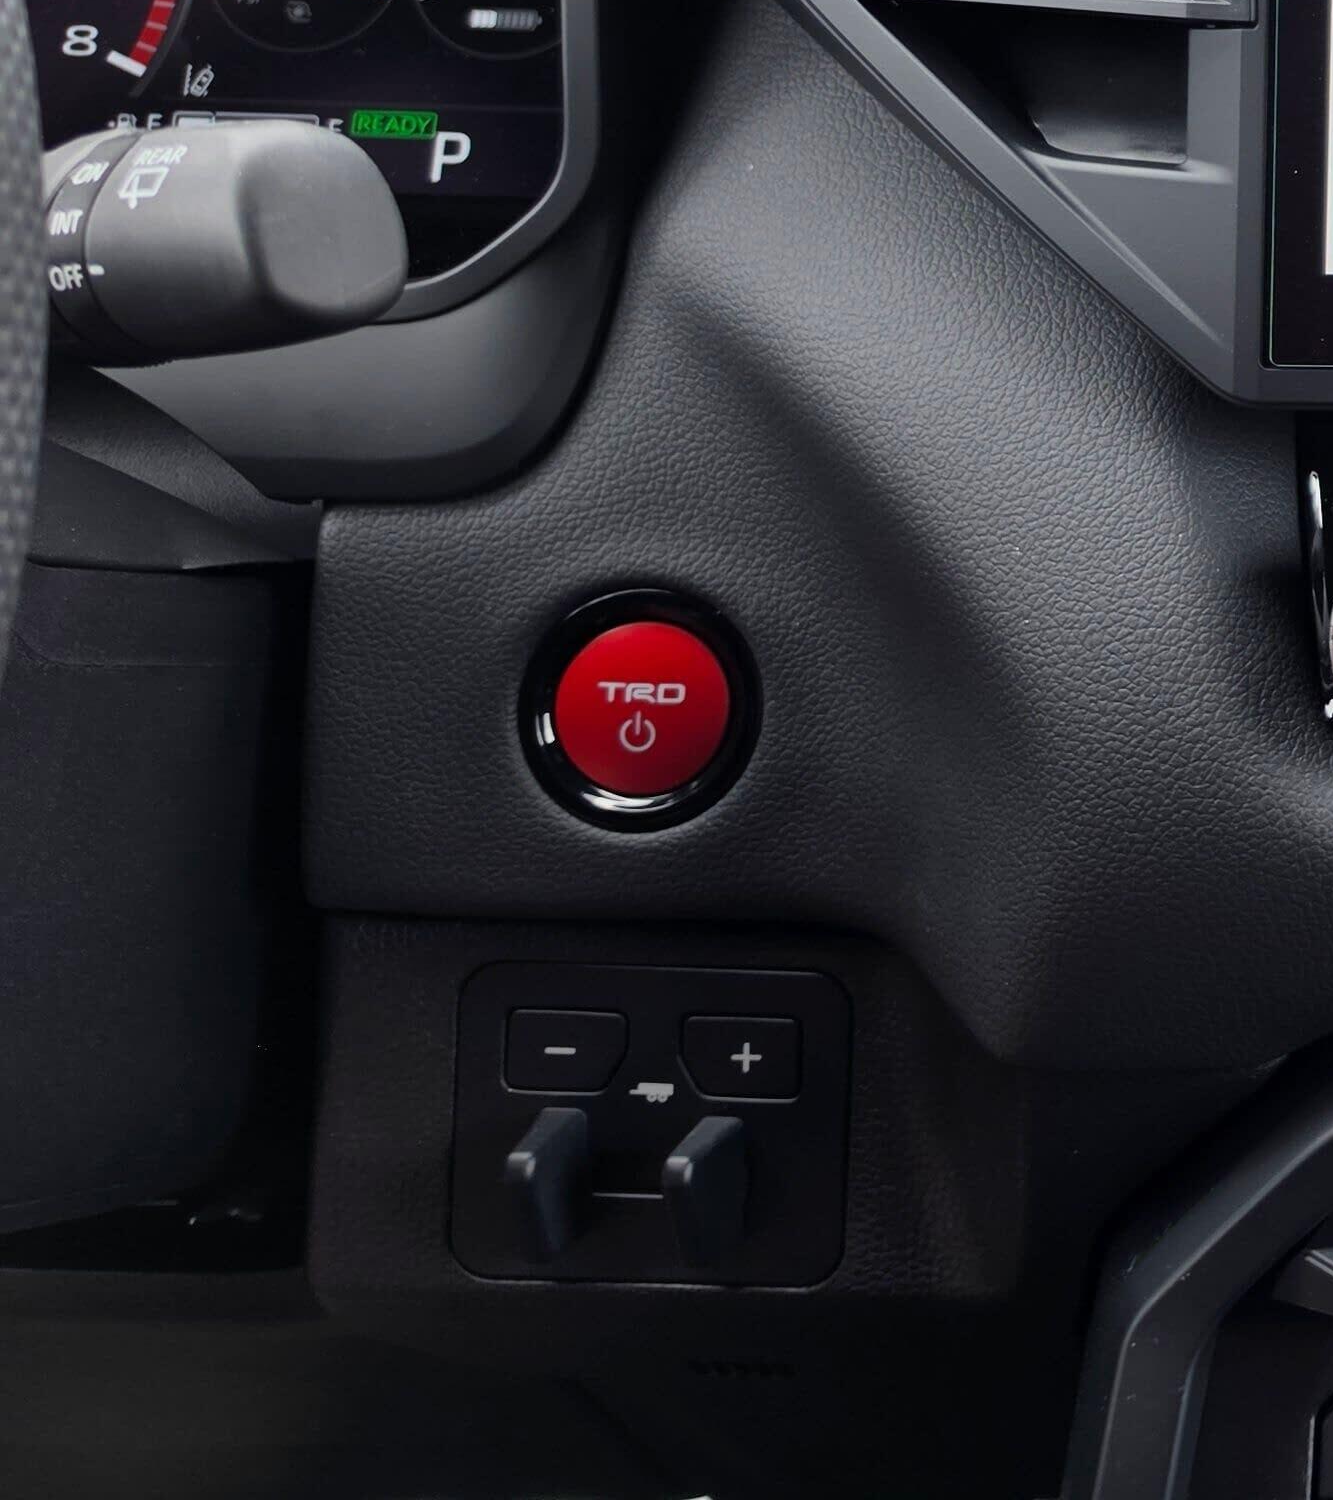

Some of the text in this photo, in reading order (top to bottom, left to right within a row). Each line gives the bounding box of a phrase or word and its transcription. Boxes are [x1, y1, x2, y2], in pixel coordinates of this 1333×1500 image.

[61, 24, 99, 57] 8
[356, 113, 434, 134] READY
[134, 145, 188, 165] REAR
[430, 131, 472, 184] P
[71, 161, 110, 185] ON
[50, 208, 84, 235] INT
[48, 262, 84, 291] OFF
[597, 681, 686, 706] TRD
